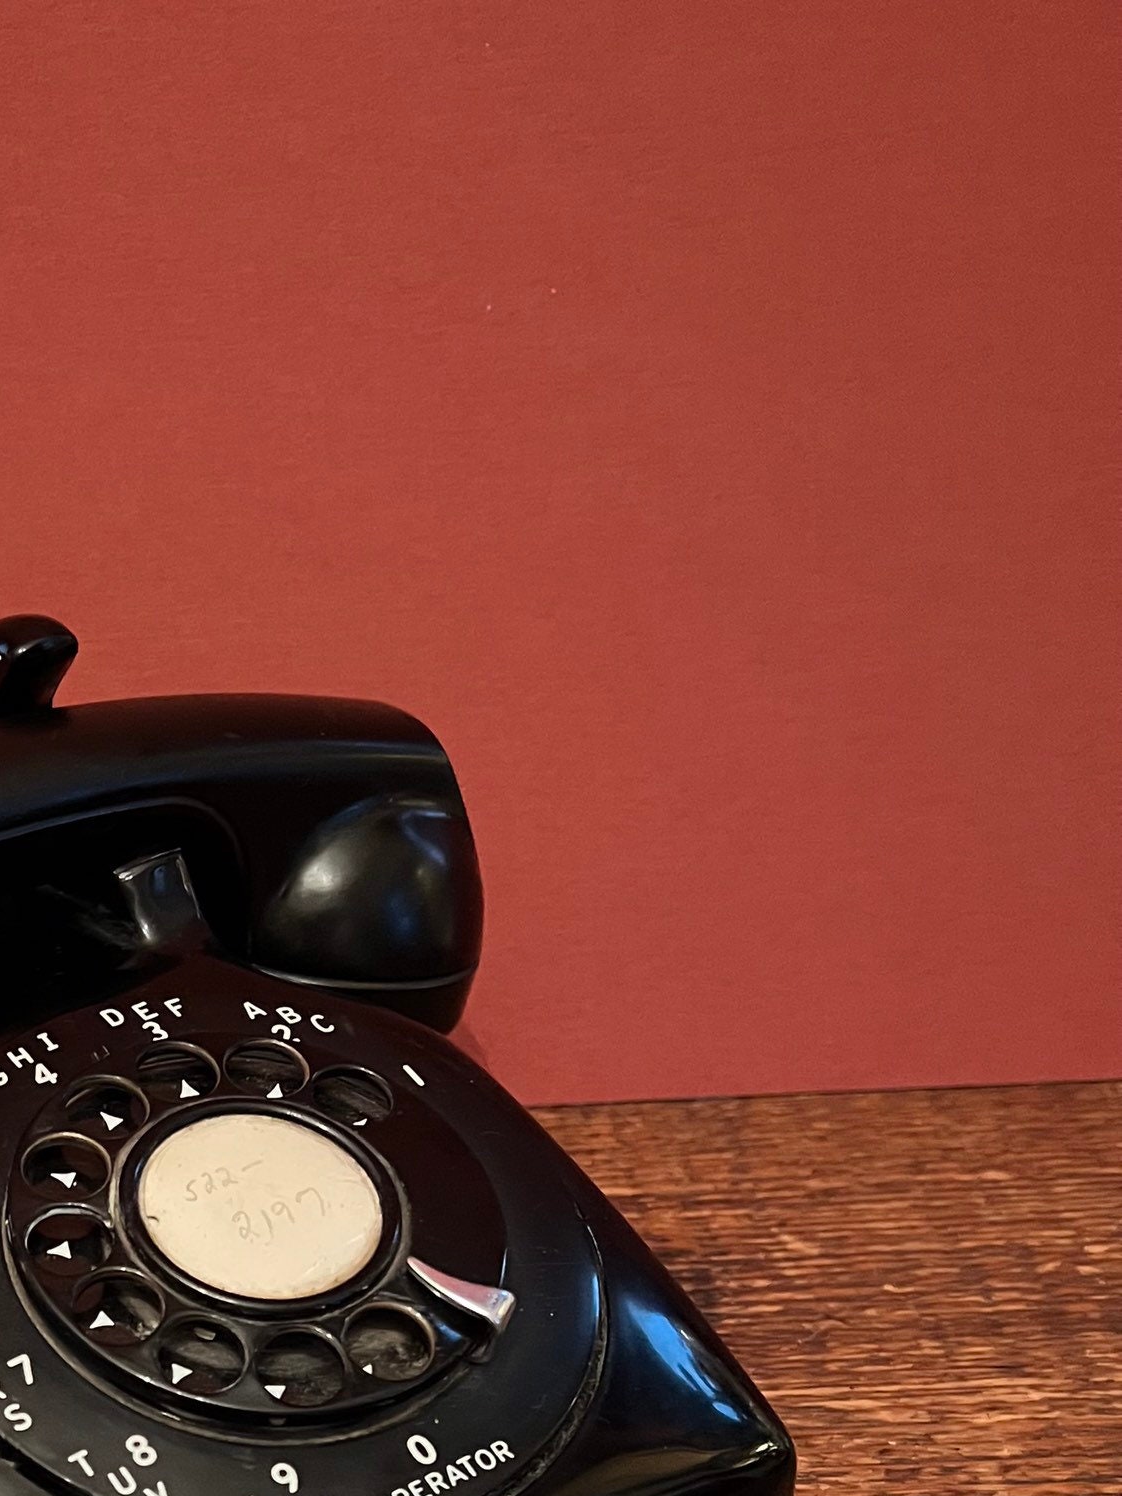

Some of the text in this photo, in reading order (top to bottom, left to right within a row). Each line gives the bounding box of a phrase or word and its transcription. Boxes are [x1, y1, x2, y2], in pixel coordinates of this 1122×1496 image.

[142, 1021, 169, 1043] 3
[34, 1062, 58, 1085] 4
[6, 1353, 34, 1386] 7
[125, 1434, 158, 1467] 8
[406, 1434, 437, 1465] 0
[270, 1462, 299, 1494] 9
